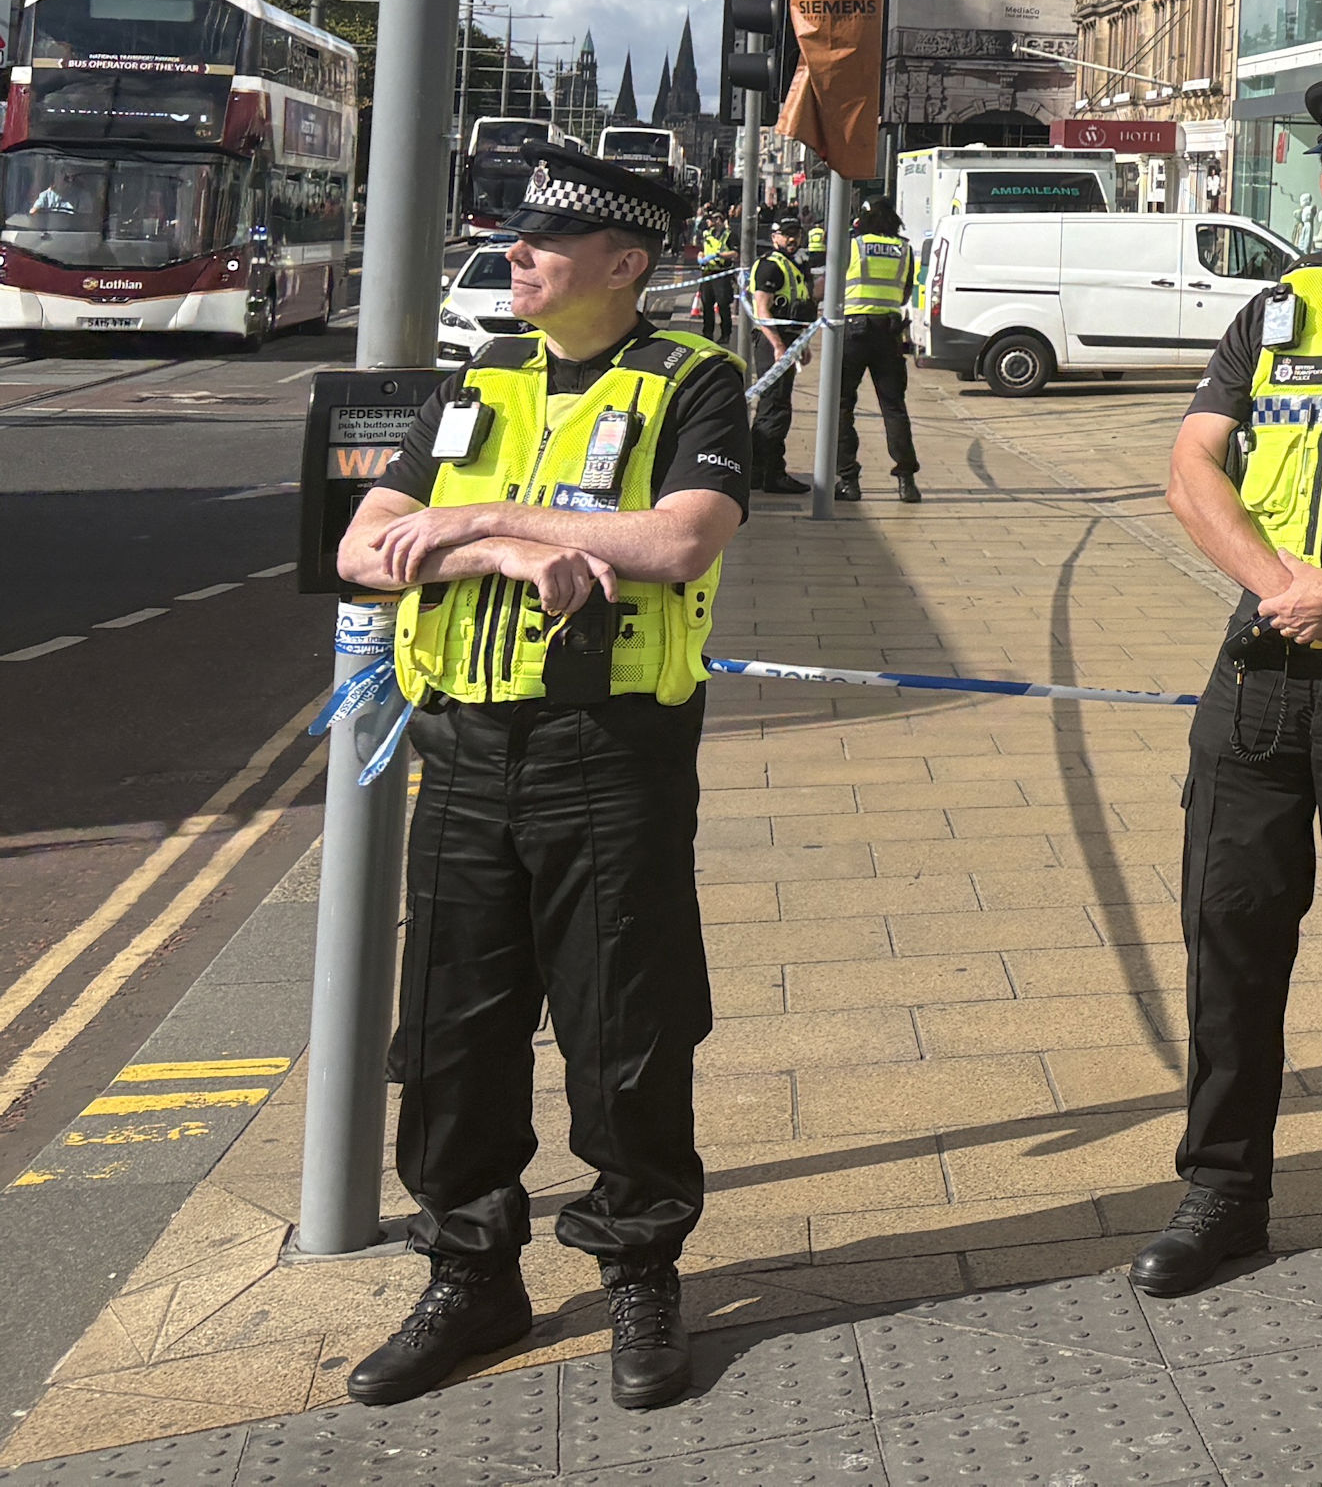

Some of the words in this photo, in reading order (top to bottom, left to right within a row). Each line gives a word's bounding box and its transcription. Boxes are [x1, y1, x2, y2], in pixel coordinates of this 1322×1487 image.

[799, 0, 876, 14] SIEMENS
[1005, 6, 1040, 15] MediaCo
[68, 59, 87, 69] BUS
[88, 60, 138, 71] OPERATOR
[139, 62, 154, 71] OF
[155, 62, 175, 72] THE
[175, 63, 199, 73] YEAR
[990, 186, 1080, 197] AMBAILEANS
[100, 279, 143, 290] Lothian
[663, 346, 689, 371] 4098
[339, 408, 416, 419] PEDESTRIA
[338, 420, 361, 430] push
[363, 420, 394, 429] button
[343, 430, 356, 439] for
[358, 430, 387, 440] signal
[696, 453, 742, 475] POLICE
[570, 492, 617, 510] POLICE
